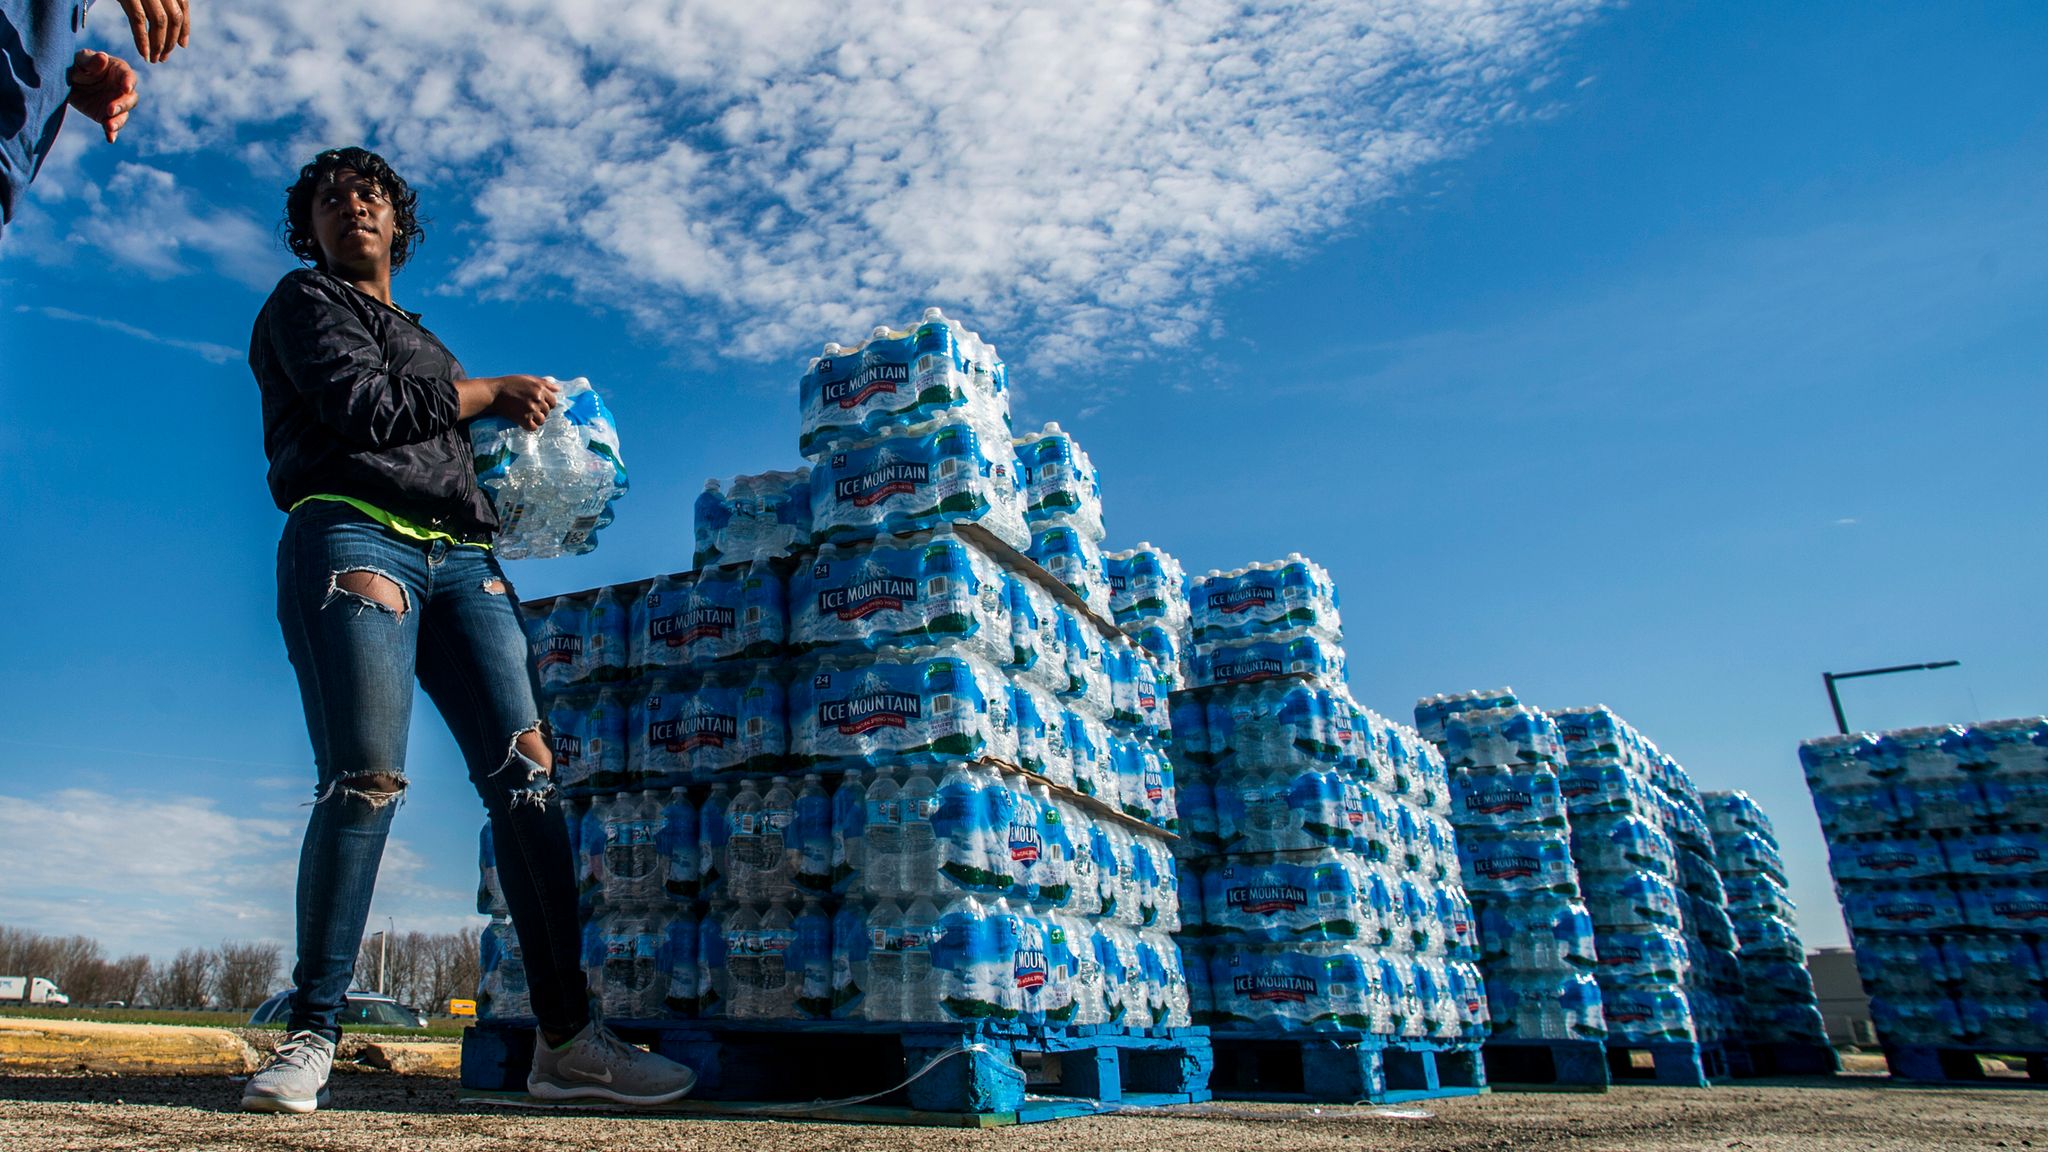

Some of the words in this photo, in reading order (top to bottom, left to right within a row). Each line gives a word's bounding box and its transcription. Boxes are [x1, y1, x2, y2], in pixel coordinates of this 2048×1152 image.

[820, 360, 830, 370] 24
[826, 383, 846, 400] ICE
[849, 366, 906, 393] MOUNTAIN
[833, 455, 844, 465] 24
[840, 479, 860, 497] ICE
[862, 465, 926, 490] MOUNTAIN
[815, 565, 827, 575] 24
[822, 591, 844, 609] ICE
[847, 579, 914, 603] MOUNTAIN
[1210, 595, 1225, 607] ICE
[1227, 588, 1273, 603] MOUNTAIN
[653, 619, 673, 636] ICE
[675, 609, 732, 631] MOUNTAIN
[1216, 666, 1232, 678] ICE
[1233, 660, 1281, 675] MOUNTAIN
[816, 675, 828, 684] 24
[648, 697, 659, 706] 24
[823, 703, 845, 722] ICE
[847, 694, 917, 717] MOUNTAIN
[652, 724, 673, 741] ICE
[675, 716, 734, 736] MOUNTAIN
[1229, 889, 1247, 903] ICE
[1249, 887, 1305, 902] MOUNTAIN
[1236, 977, 1254, 991] ICE
[1256, 975, 1315, 992] MOUNTAIN
